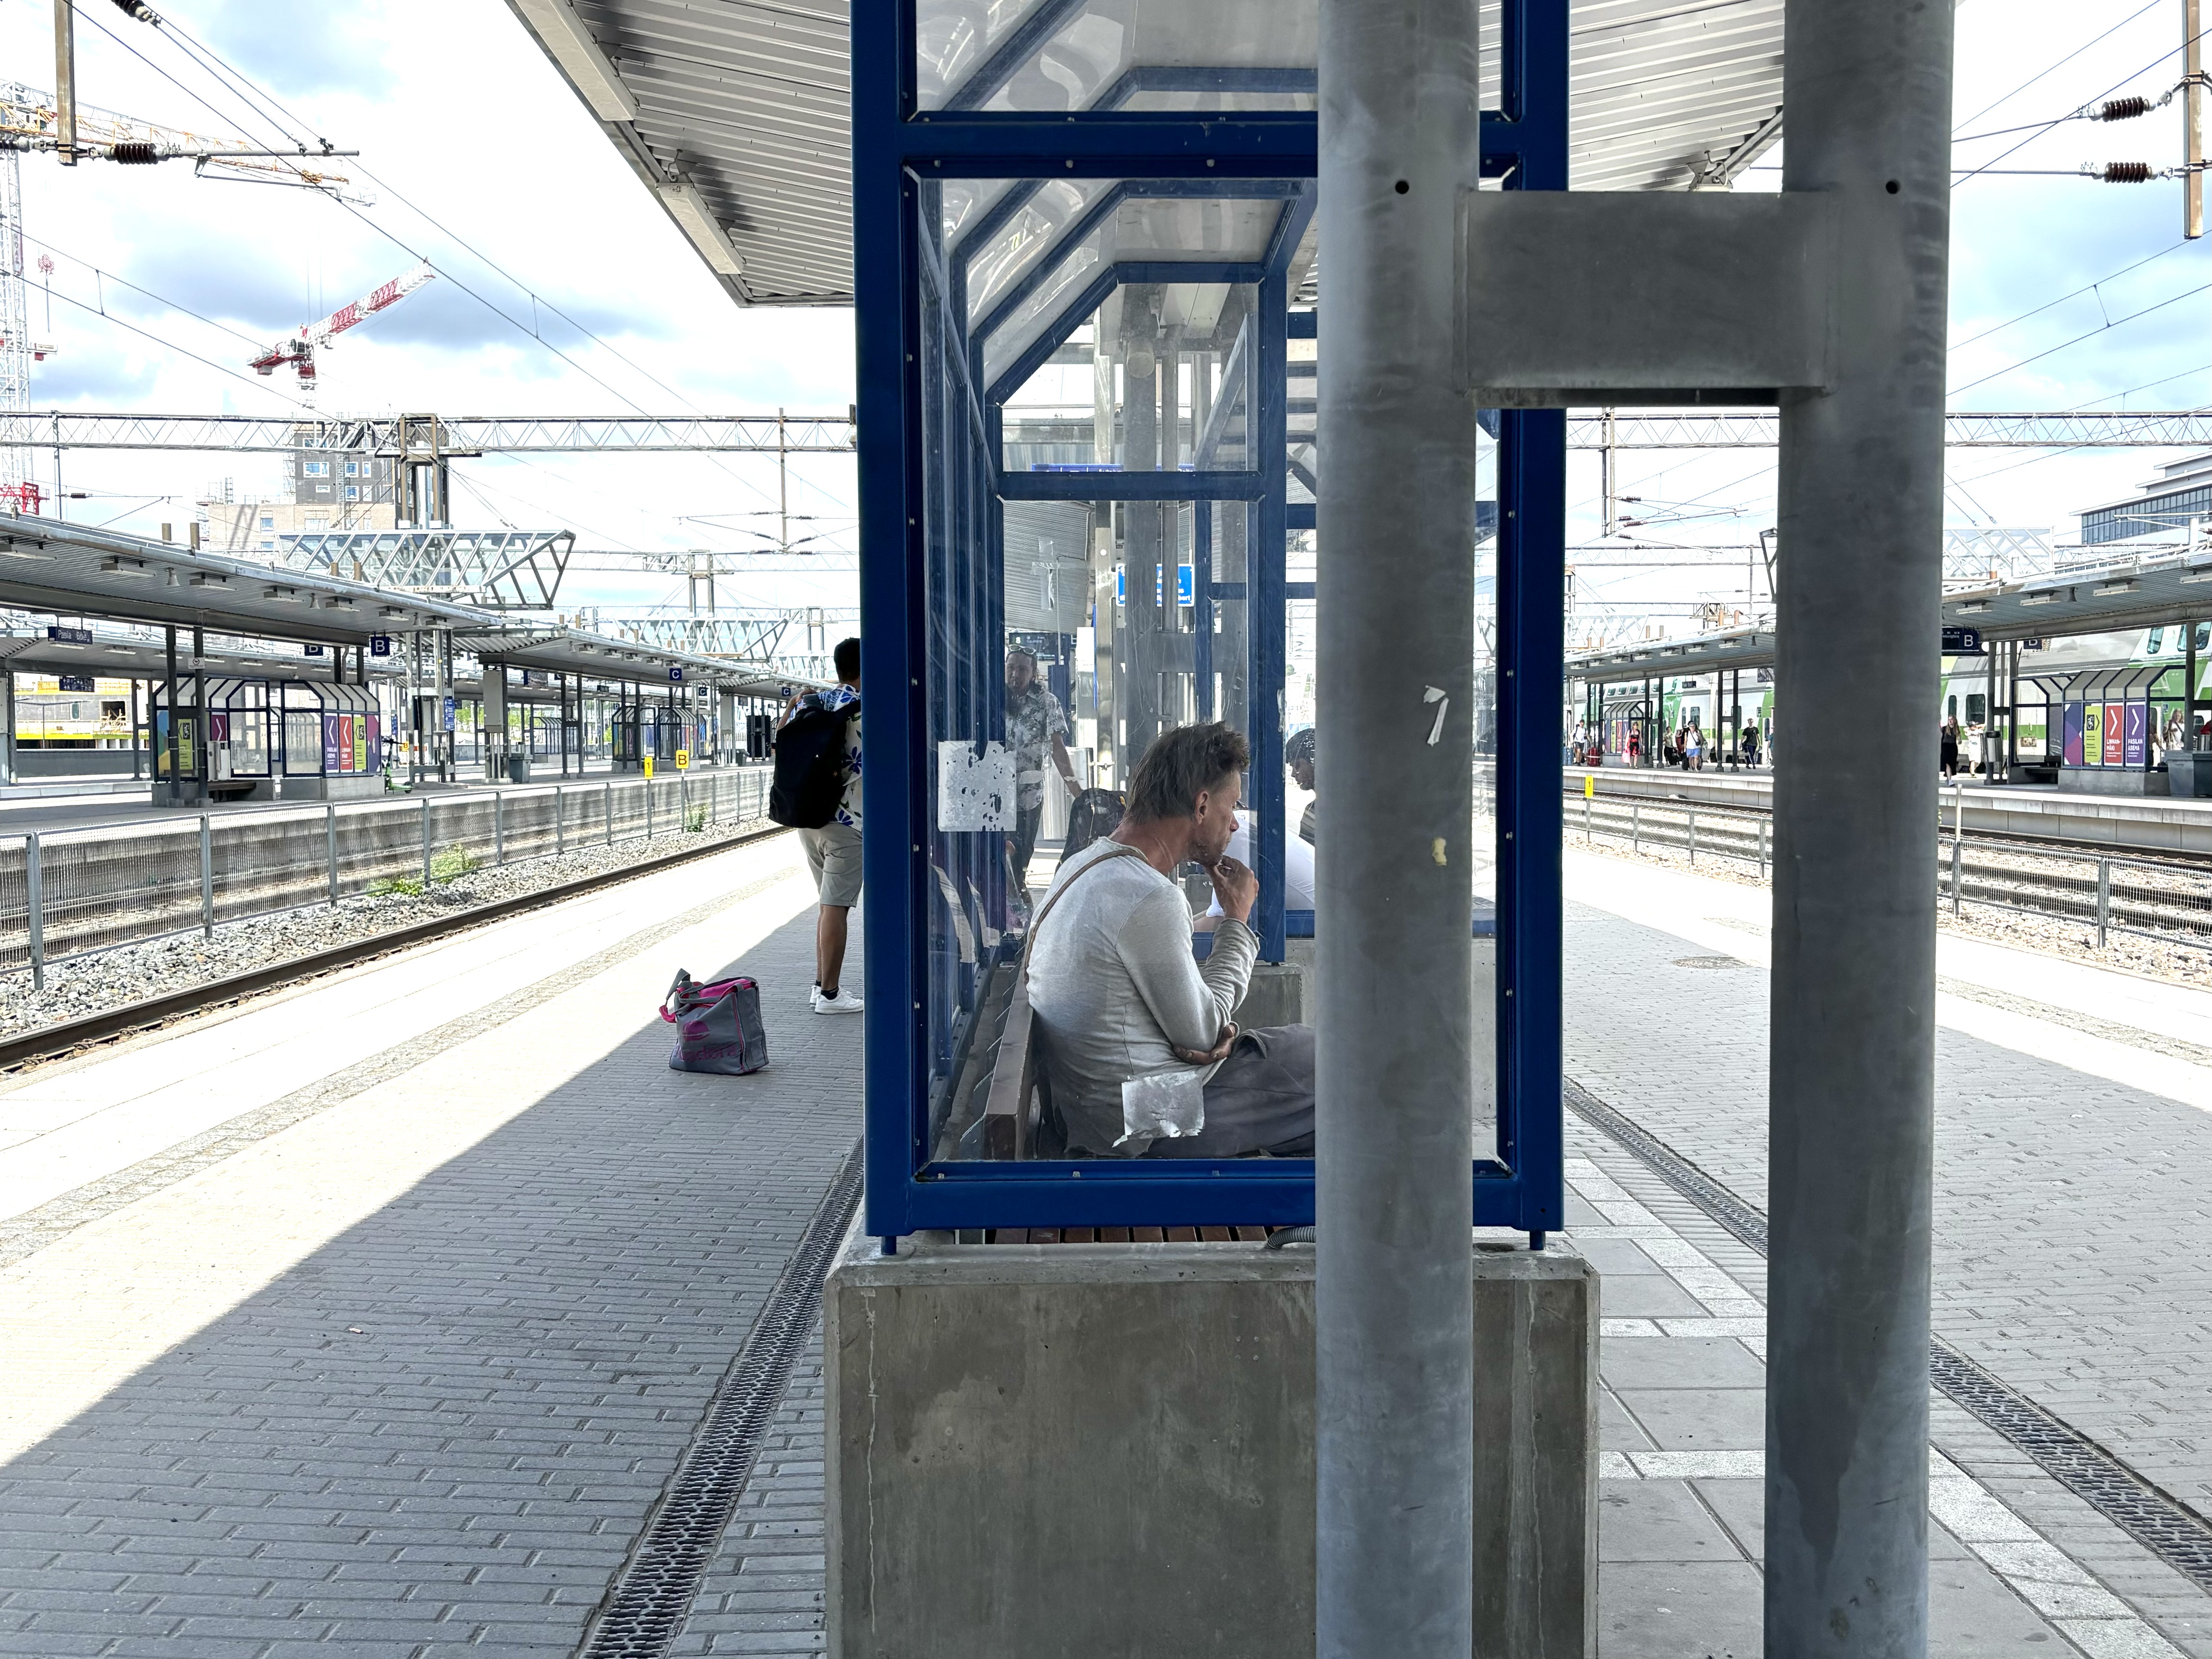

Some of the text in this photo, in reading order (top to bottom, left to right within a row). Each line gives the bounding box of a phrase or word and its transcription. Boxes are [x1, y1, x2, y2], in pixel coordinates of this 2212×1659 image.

[375, 640, 385, 652] B
[1964, 635, 1973, 647] B
[672, 670, 679, 679] C
[678, 755, 687, 765] B
